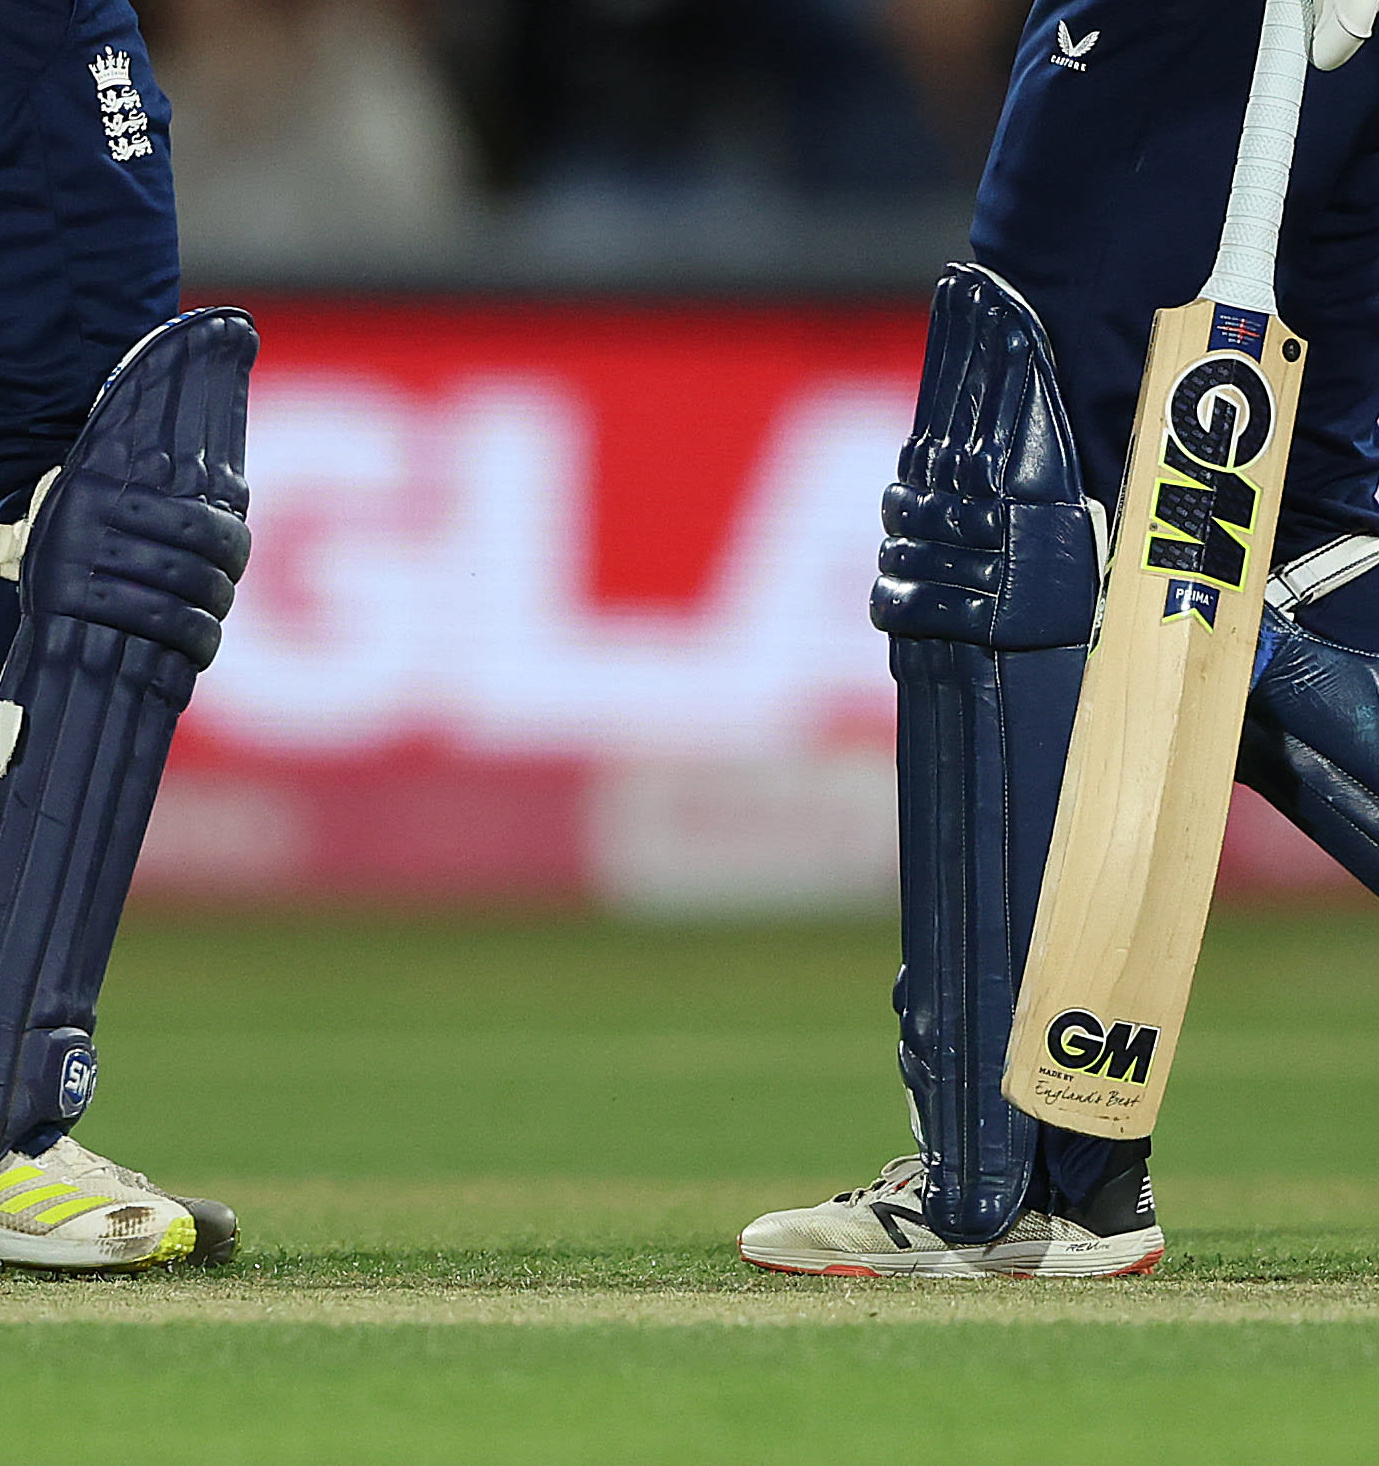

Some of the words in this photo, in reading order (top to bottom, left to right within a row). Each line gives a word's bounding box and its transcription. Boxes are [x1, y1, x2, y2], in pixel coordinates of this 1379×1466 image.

[1050, 54, 1087, 72] CASTORE
[1140, 351, 1277, 592] GM
[1175, 587, 1210, 606] PRIMA
[1044, 1007, 1162, 1088] GM
[1039, 1066, 1062, 1079] MADE
[1063, 1074, 1074, 1082] BY
[1034, 1080, 1103, 1106] England's
[1106, 1090, 1141, 1107] Best
